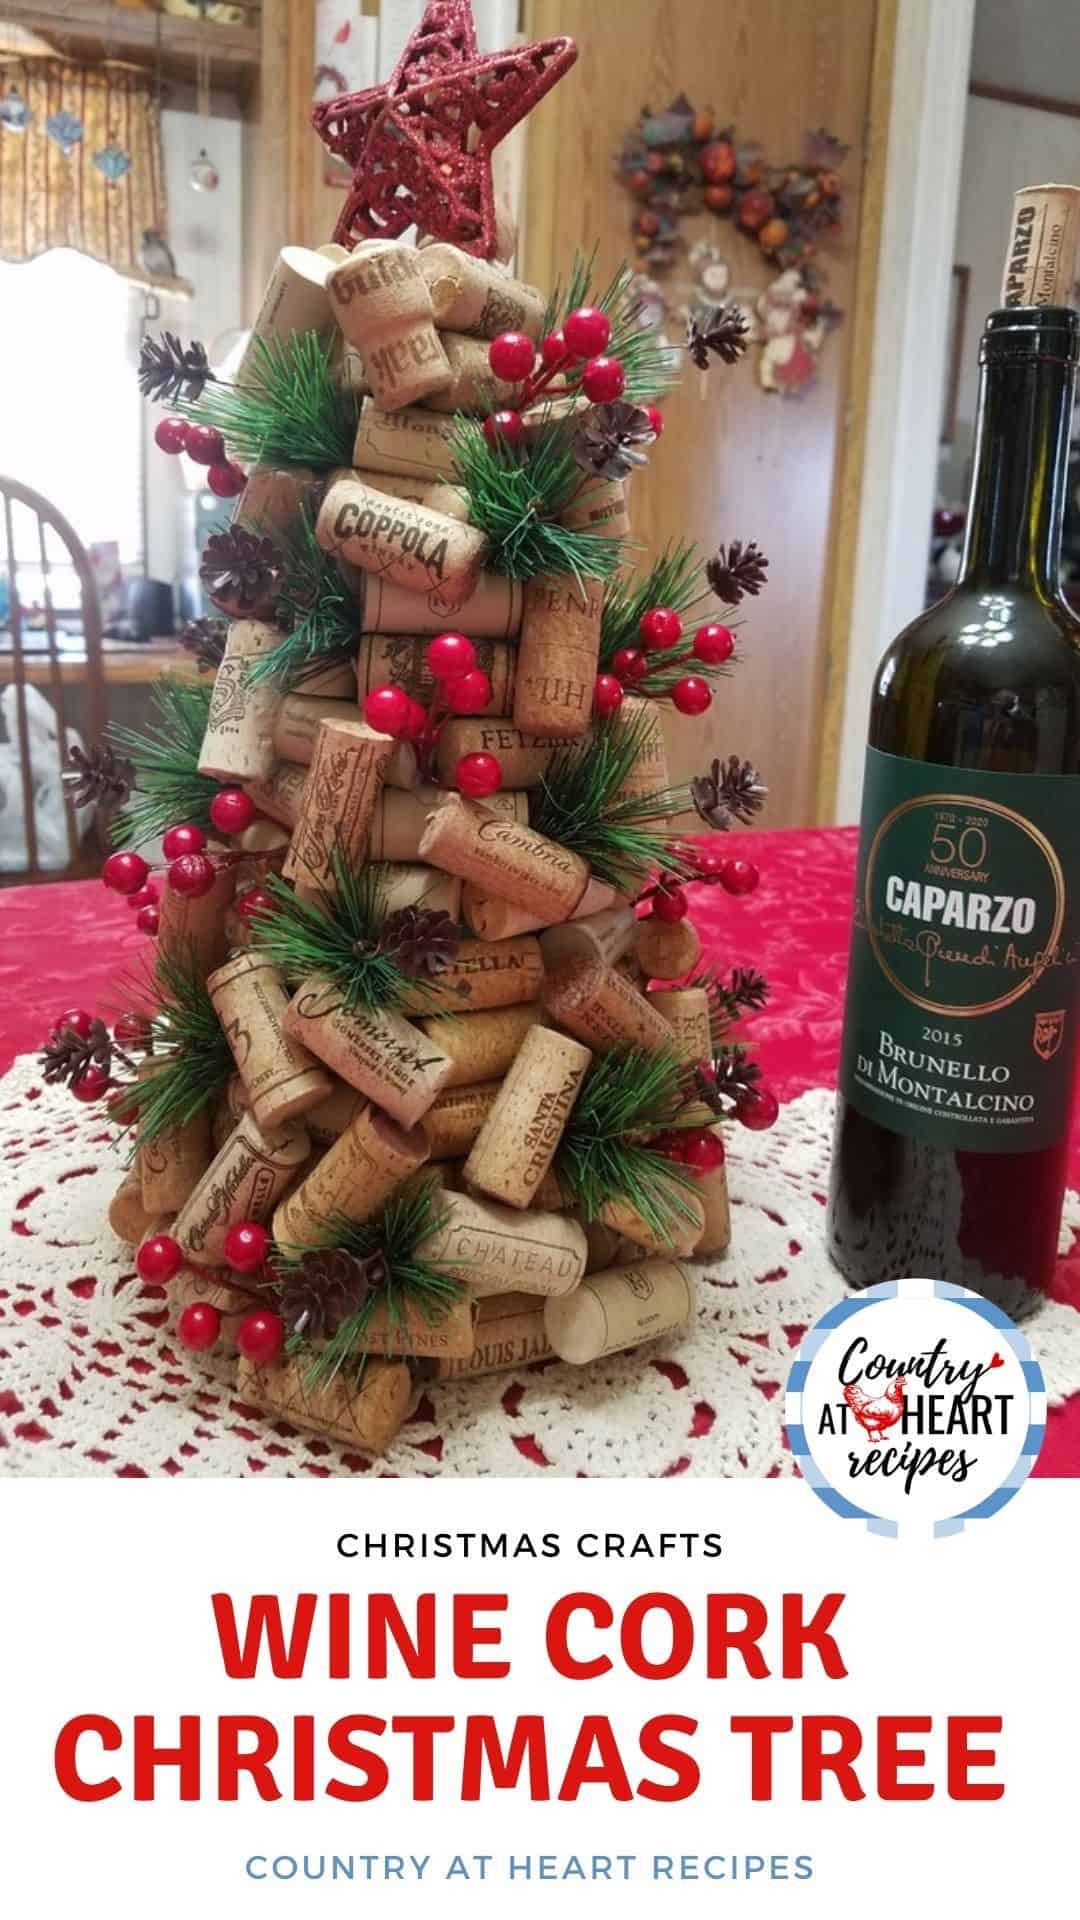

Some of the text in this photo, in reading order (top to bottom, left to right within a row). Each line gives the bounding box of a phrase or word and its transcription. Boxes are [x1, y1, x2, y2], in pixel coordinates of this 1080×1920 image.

[334, 503, 449, 574] COPPOLA
[478, 820, 576, 875] Cambria
[923, 863, 991, 884] ANNIVERSARY
[930, 823, 987, 870] 50
[885, 875, 1037, 935] CAPARZO
[878, 1029, 1011, 1085] BRUNELLO
[921, 1026, 964, 1048] 2015
[856, 1054, 1035, 1112] DI MONTALCINO
[522, 1069, 583, 1186] CRISTINA
[523, 1092, 558, 1147] SANTA
[456, 1236, 573, 1279] CHATEAU
